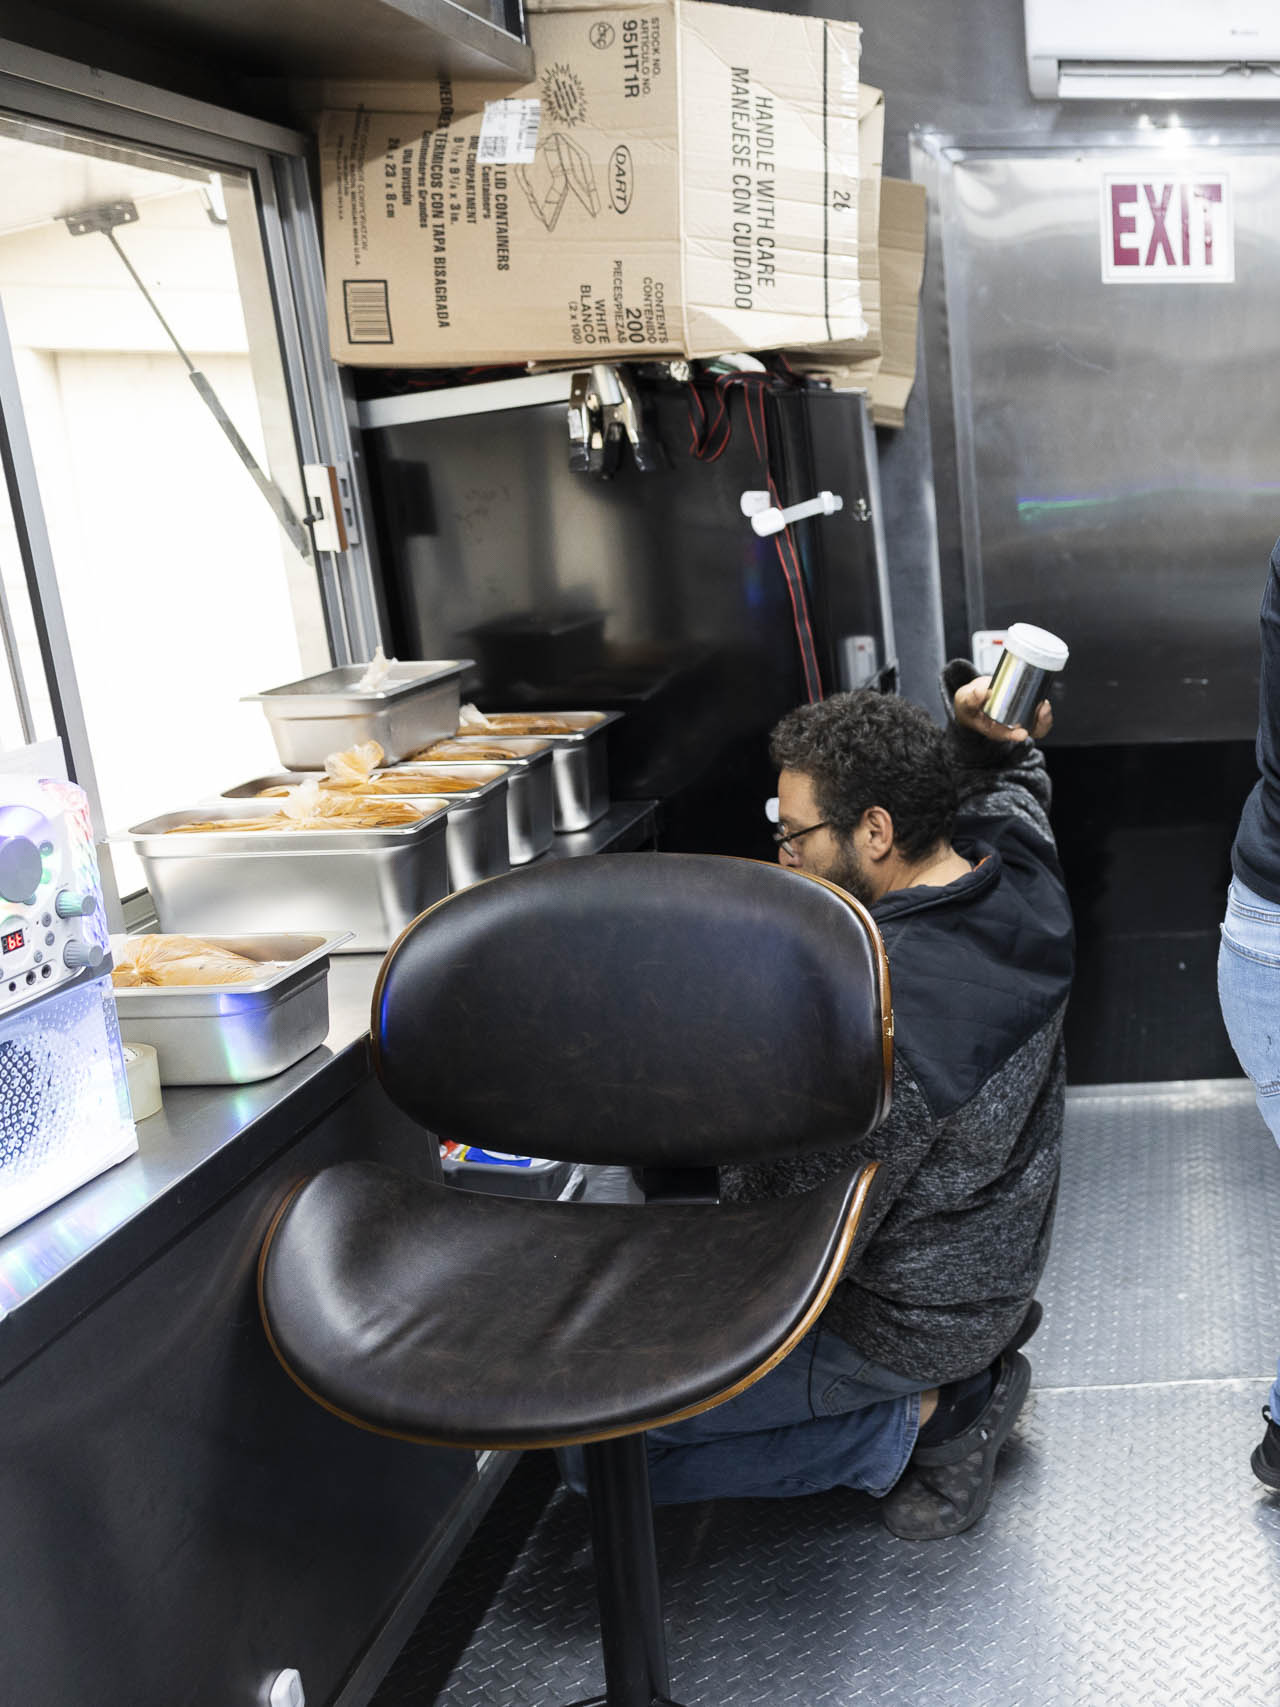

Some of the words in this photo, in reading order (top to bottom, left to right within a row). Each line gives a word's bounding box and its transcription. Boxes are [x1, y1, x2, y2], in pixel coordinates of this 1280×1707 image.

[622, 20, 640, 99] 95HT1R
[651, 17, 661, 54] STOCK
[641, 77, 651, 98] NO.
[652, 58, 661, 79] NO.
[755, 96, 775, 172] HANDLE
[385, 163, 397, 178] 23
[465, 153, 478, 224] COMPARTMENT
[481, 165, 493, 219] Containers
[494, 170, 507, 190] LID
[615, 152, 627, 206] DART
[732, 174, 752, 215] CON
[386, 203, 396, 218] cm
[431, 192, 445, 219] CON
[756, 179, 775, 229] WITH
[1111, 184, 1222, 266] EXIT
[432, 223, 446, 253] TAPA
[495, 194, 510, 271] CONTAINERS
[733, 222, 754, 309] CUIDADO
[757, 237, 776, 288] CARE
[433, 256, 451, 329] BISAGRADA
[580, 284, 596, 345] BLANCO
[613, 260, 627, 344] PIECES/PIEZAS
[642, 276, 658, 344] CONTENIDO
[654, 282, 668, 343] CONTENTS
[594, 298, 610, 344] WHITE
[625, 307, 646, 344] 200
